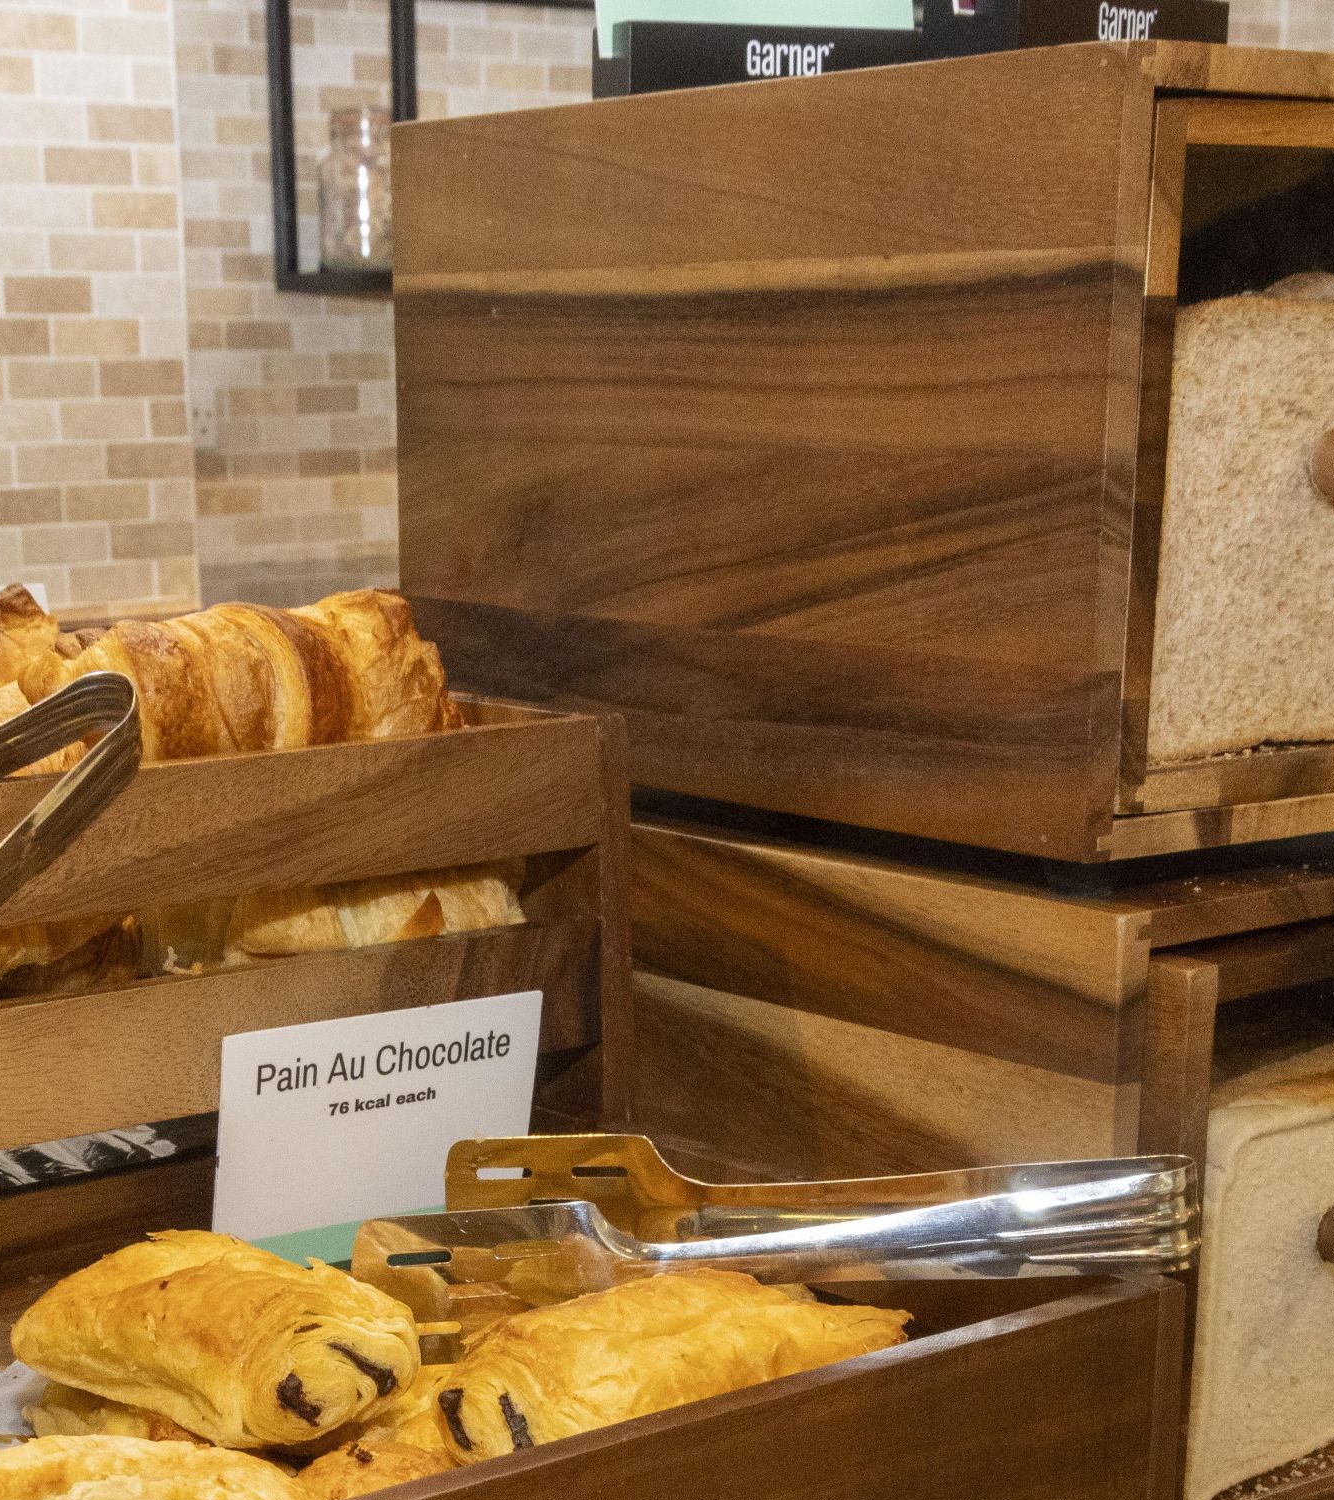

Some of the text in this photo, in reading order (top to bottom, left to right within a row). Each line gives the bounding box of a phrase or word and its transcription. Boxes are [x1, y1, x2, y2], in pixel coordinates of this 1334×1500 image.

[256, 1030, 511, 1095] Pain Au Chocolate
[328, 1087, 436, 1116] 76 kcal each
